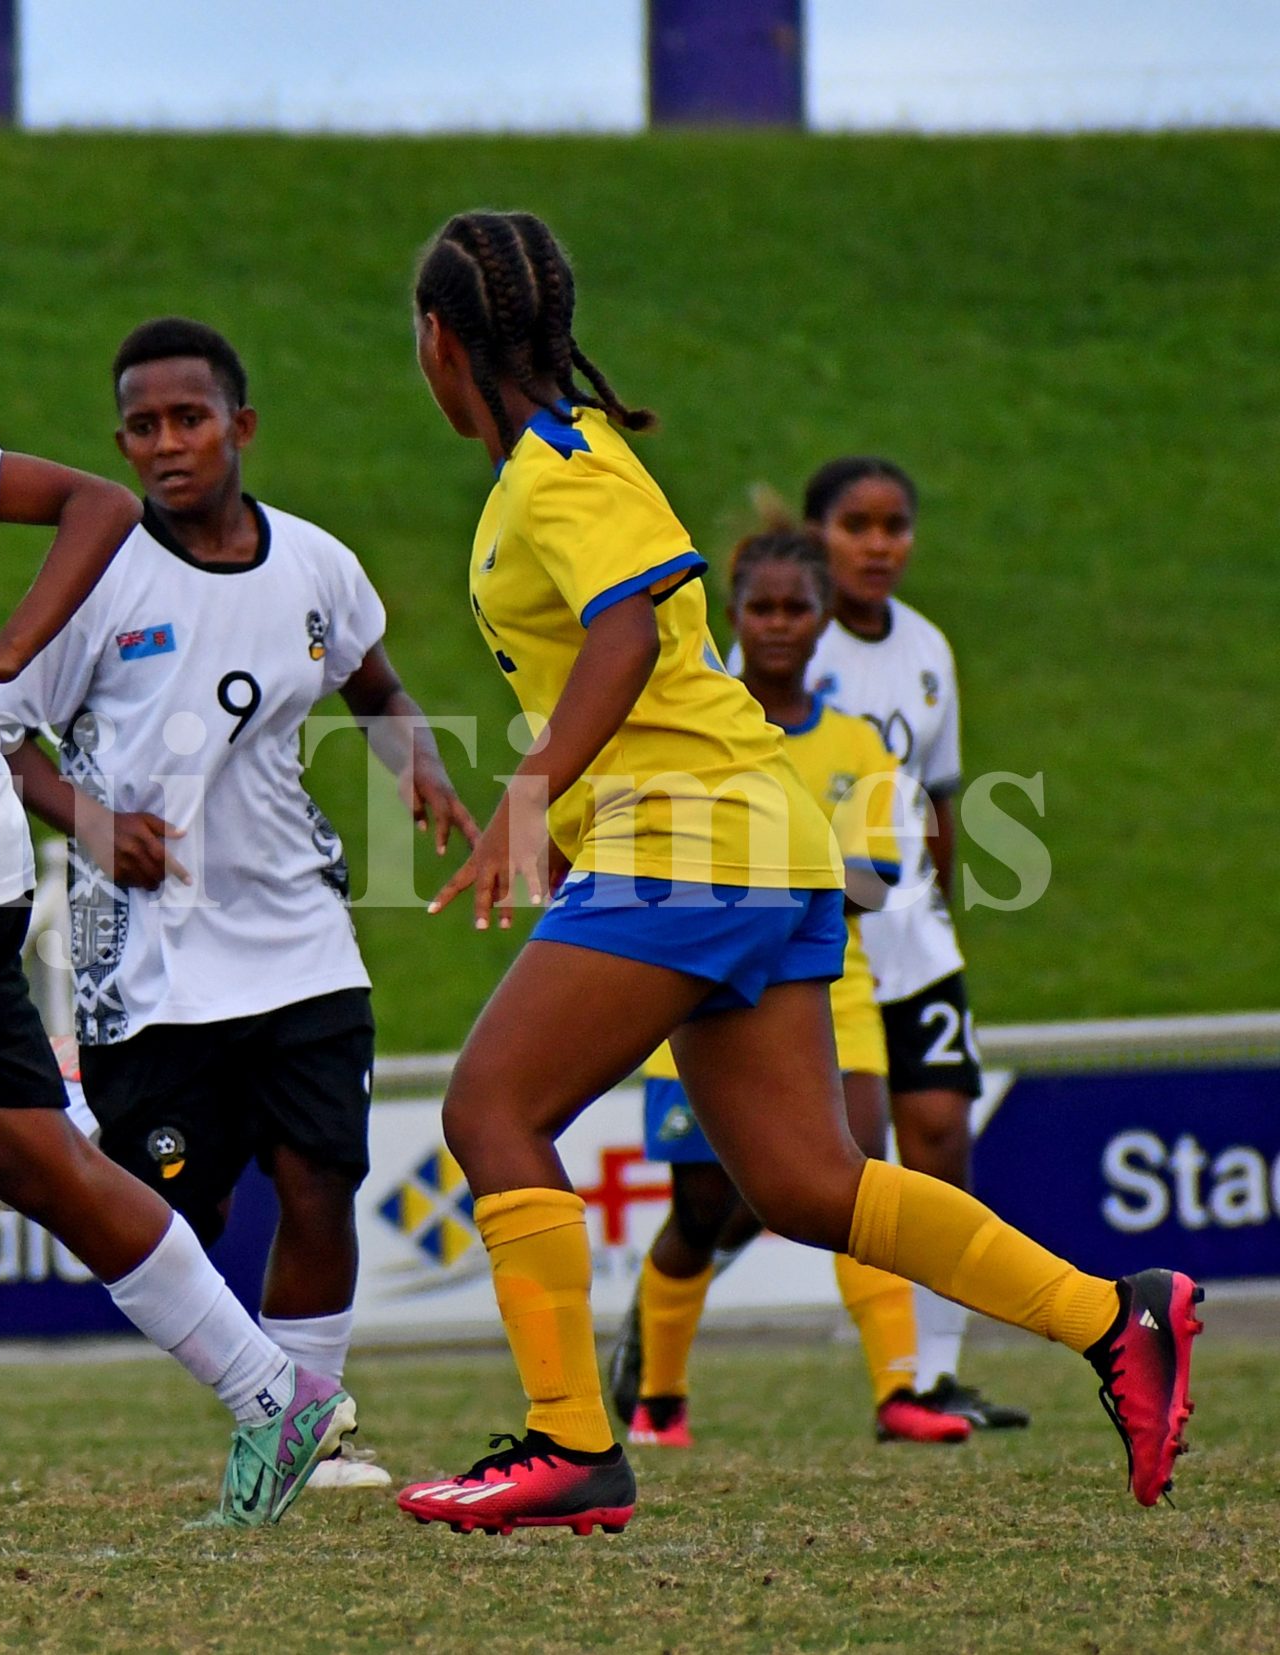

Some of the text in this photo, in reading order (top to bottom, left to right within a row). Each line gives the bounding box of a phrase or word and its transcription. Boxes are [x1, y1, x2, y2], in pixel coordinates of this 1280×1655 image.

[216, 669, 262, 745] 9
[859, 708, 914, 765] 0
[919, 1001, 980, 1065] 2
[1100, 1130, 1280, 1232] Sta
